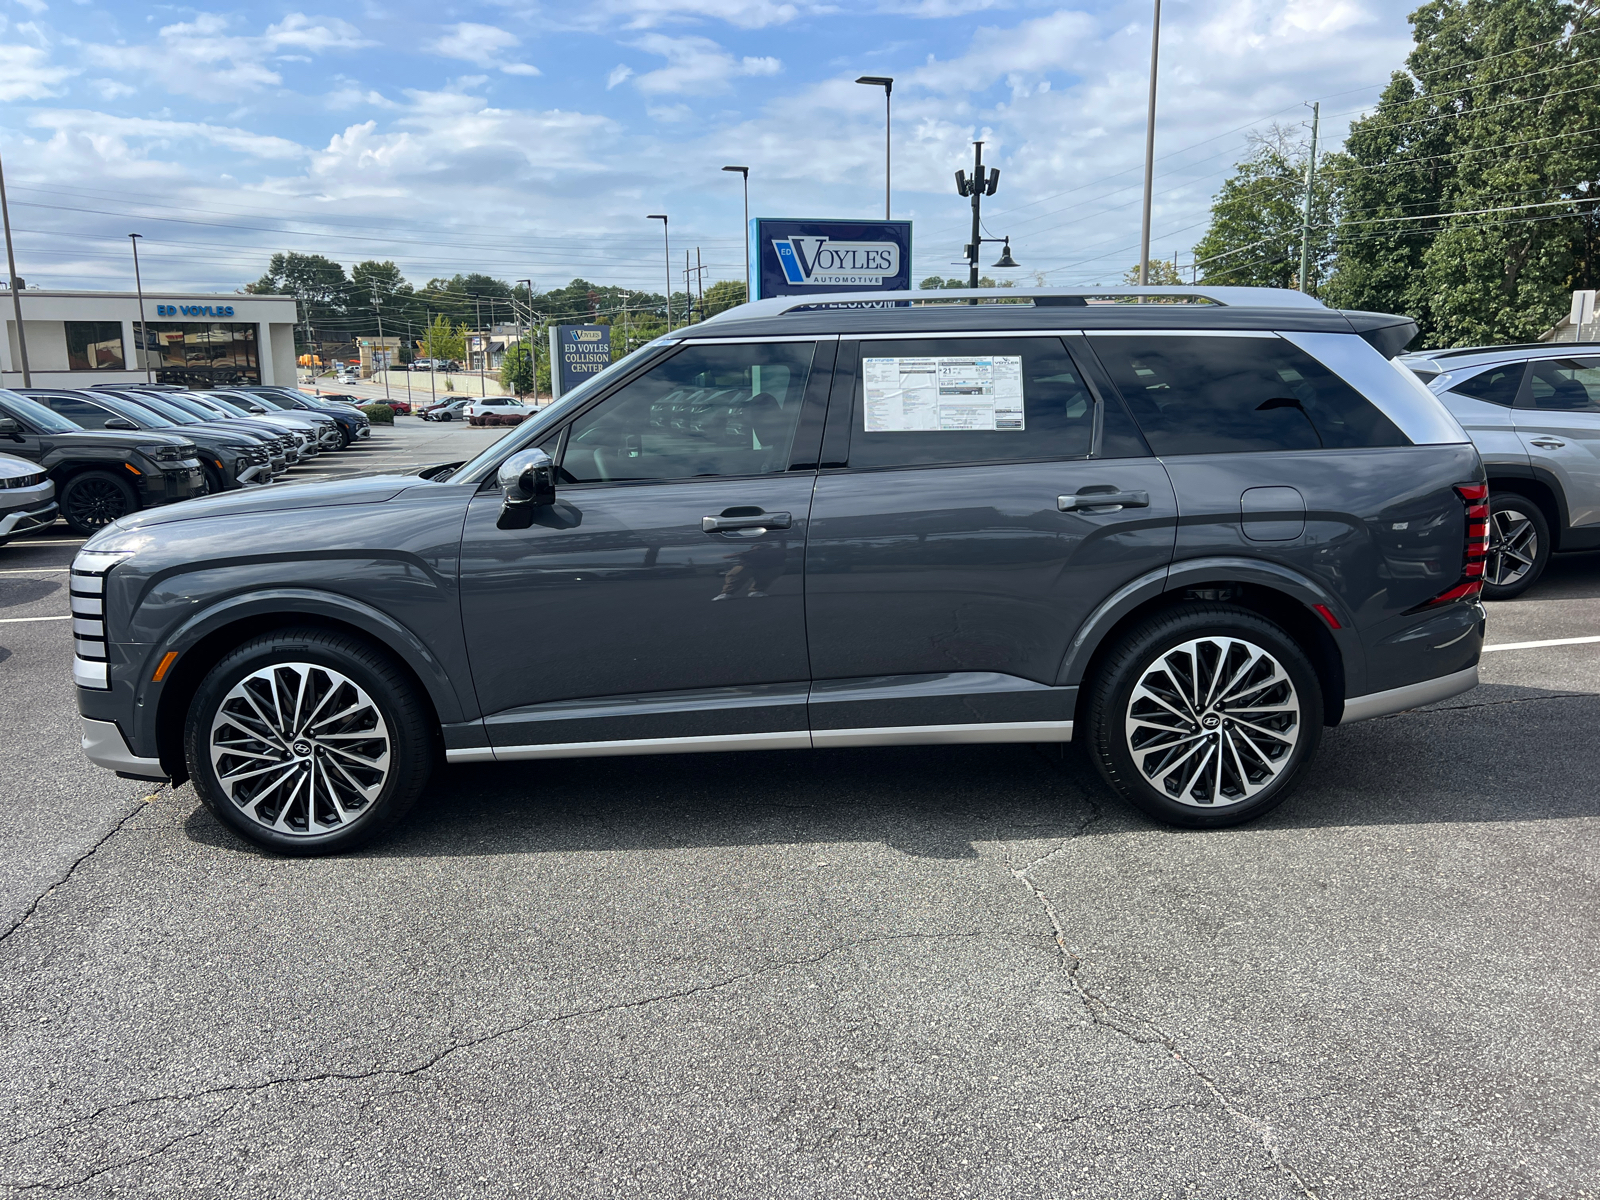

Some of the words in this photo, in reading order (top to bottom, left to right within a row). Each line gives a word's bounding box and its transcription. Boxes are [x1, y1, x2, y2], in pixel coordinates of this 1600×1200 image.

[791, 238, 892, 278] VOYLES
[157, 304, 177, 316] ED
[179, 305, 235, 317] VOYLES
[564, 344, 576, 352] ED
[578, 344, 609, 352] VOYLES
[565, 354, 609, 362] COLLISION
[571, 364, 604, 372] CENTER
